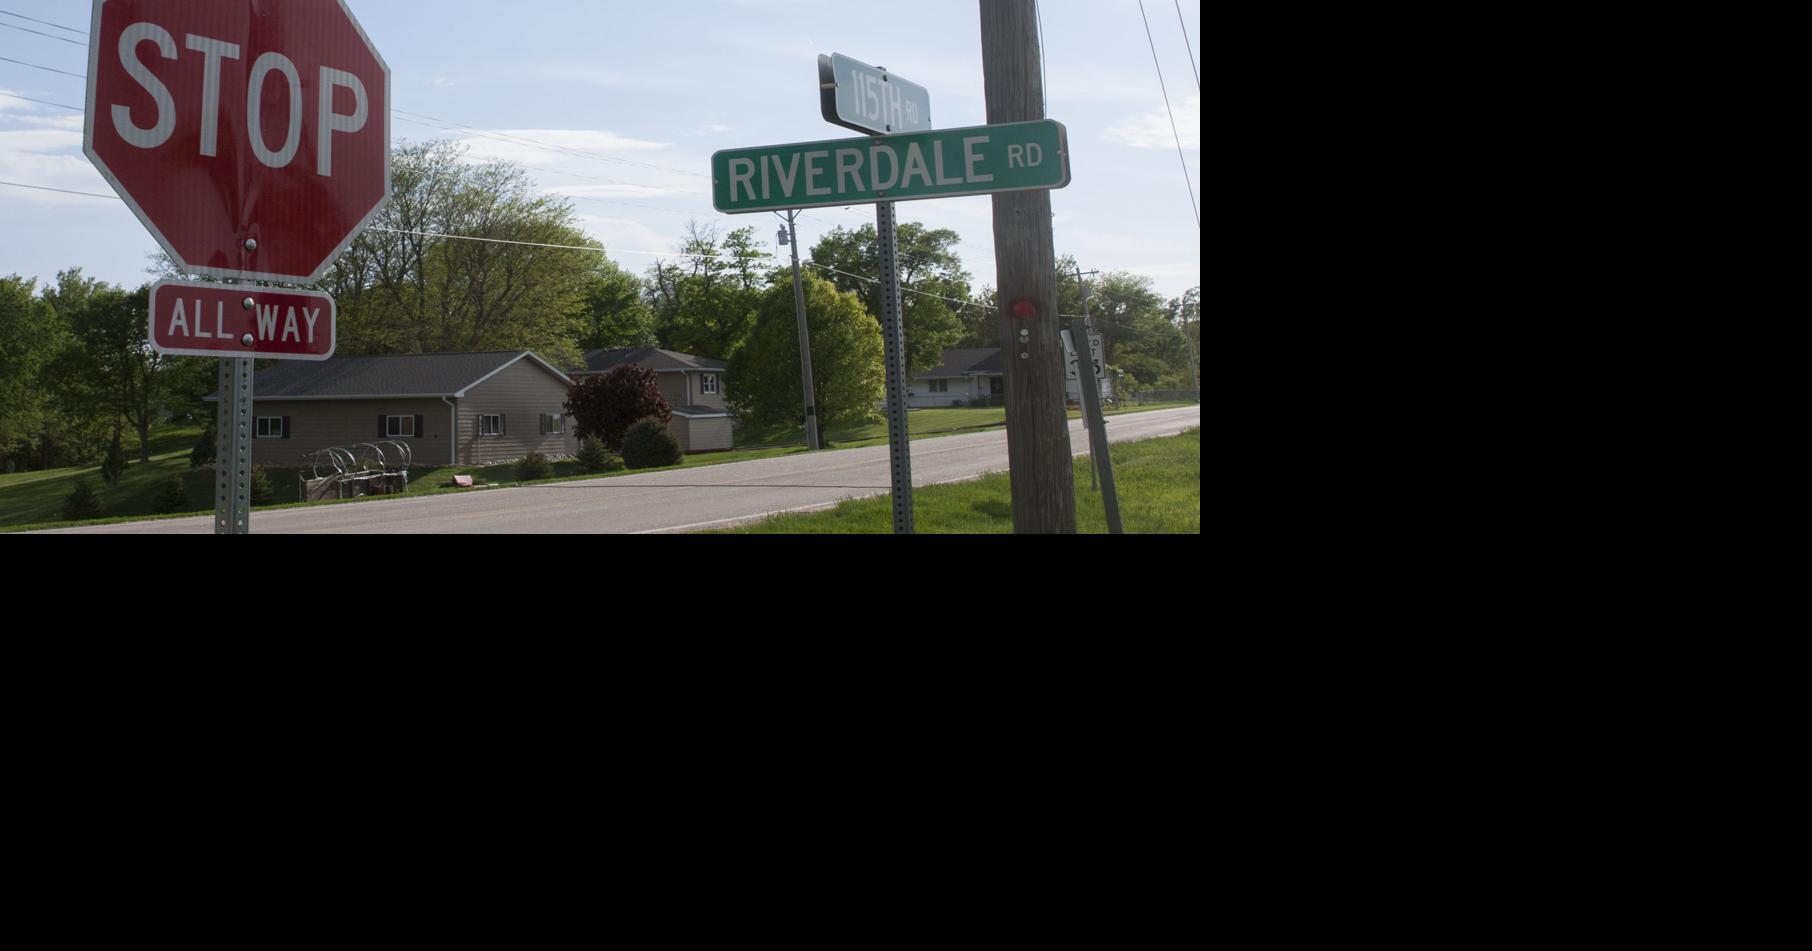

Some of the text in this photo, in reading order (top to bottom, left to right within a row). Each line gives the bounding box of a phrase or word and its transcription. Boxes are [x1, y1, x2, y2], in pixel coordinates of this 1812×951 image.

[111, 22, 369, 177] STOP
[851, 69, 919, 130] 115TH RD
[728, 135, 1043, 202] RIVERDALE RD
[167, 298, 321, 343] ALL WAY
